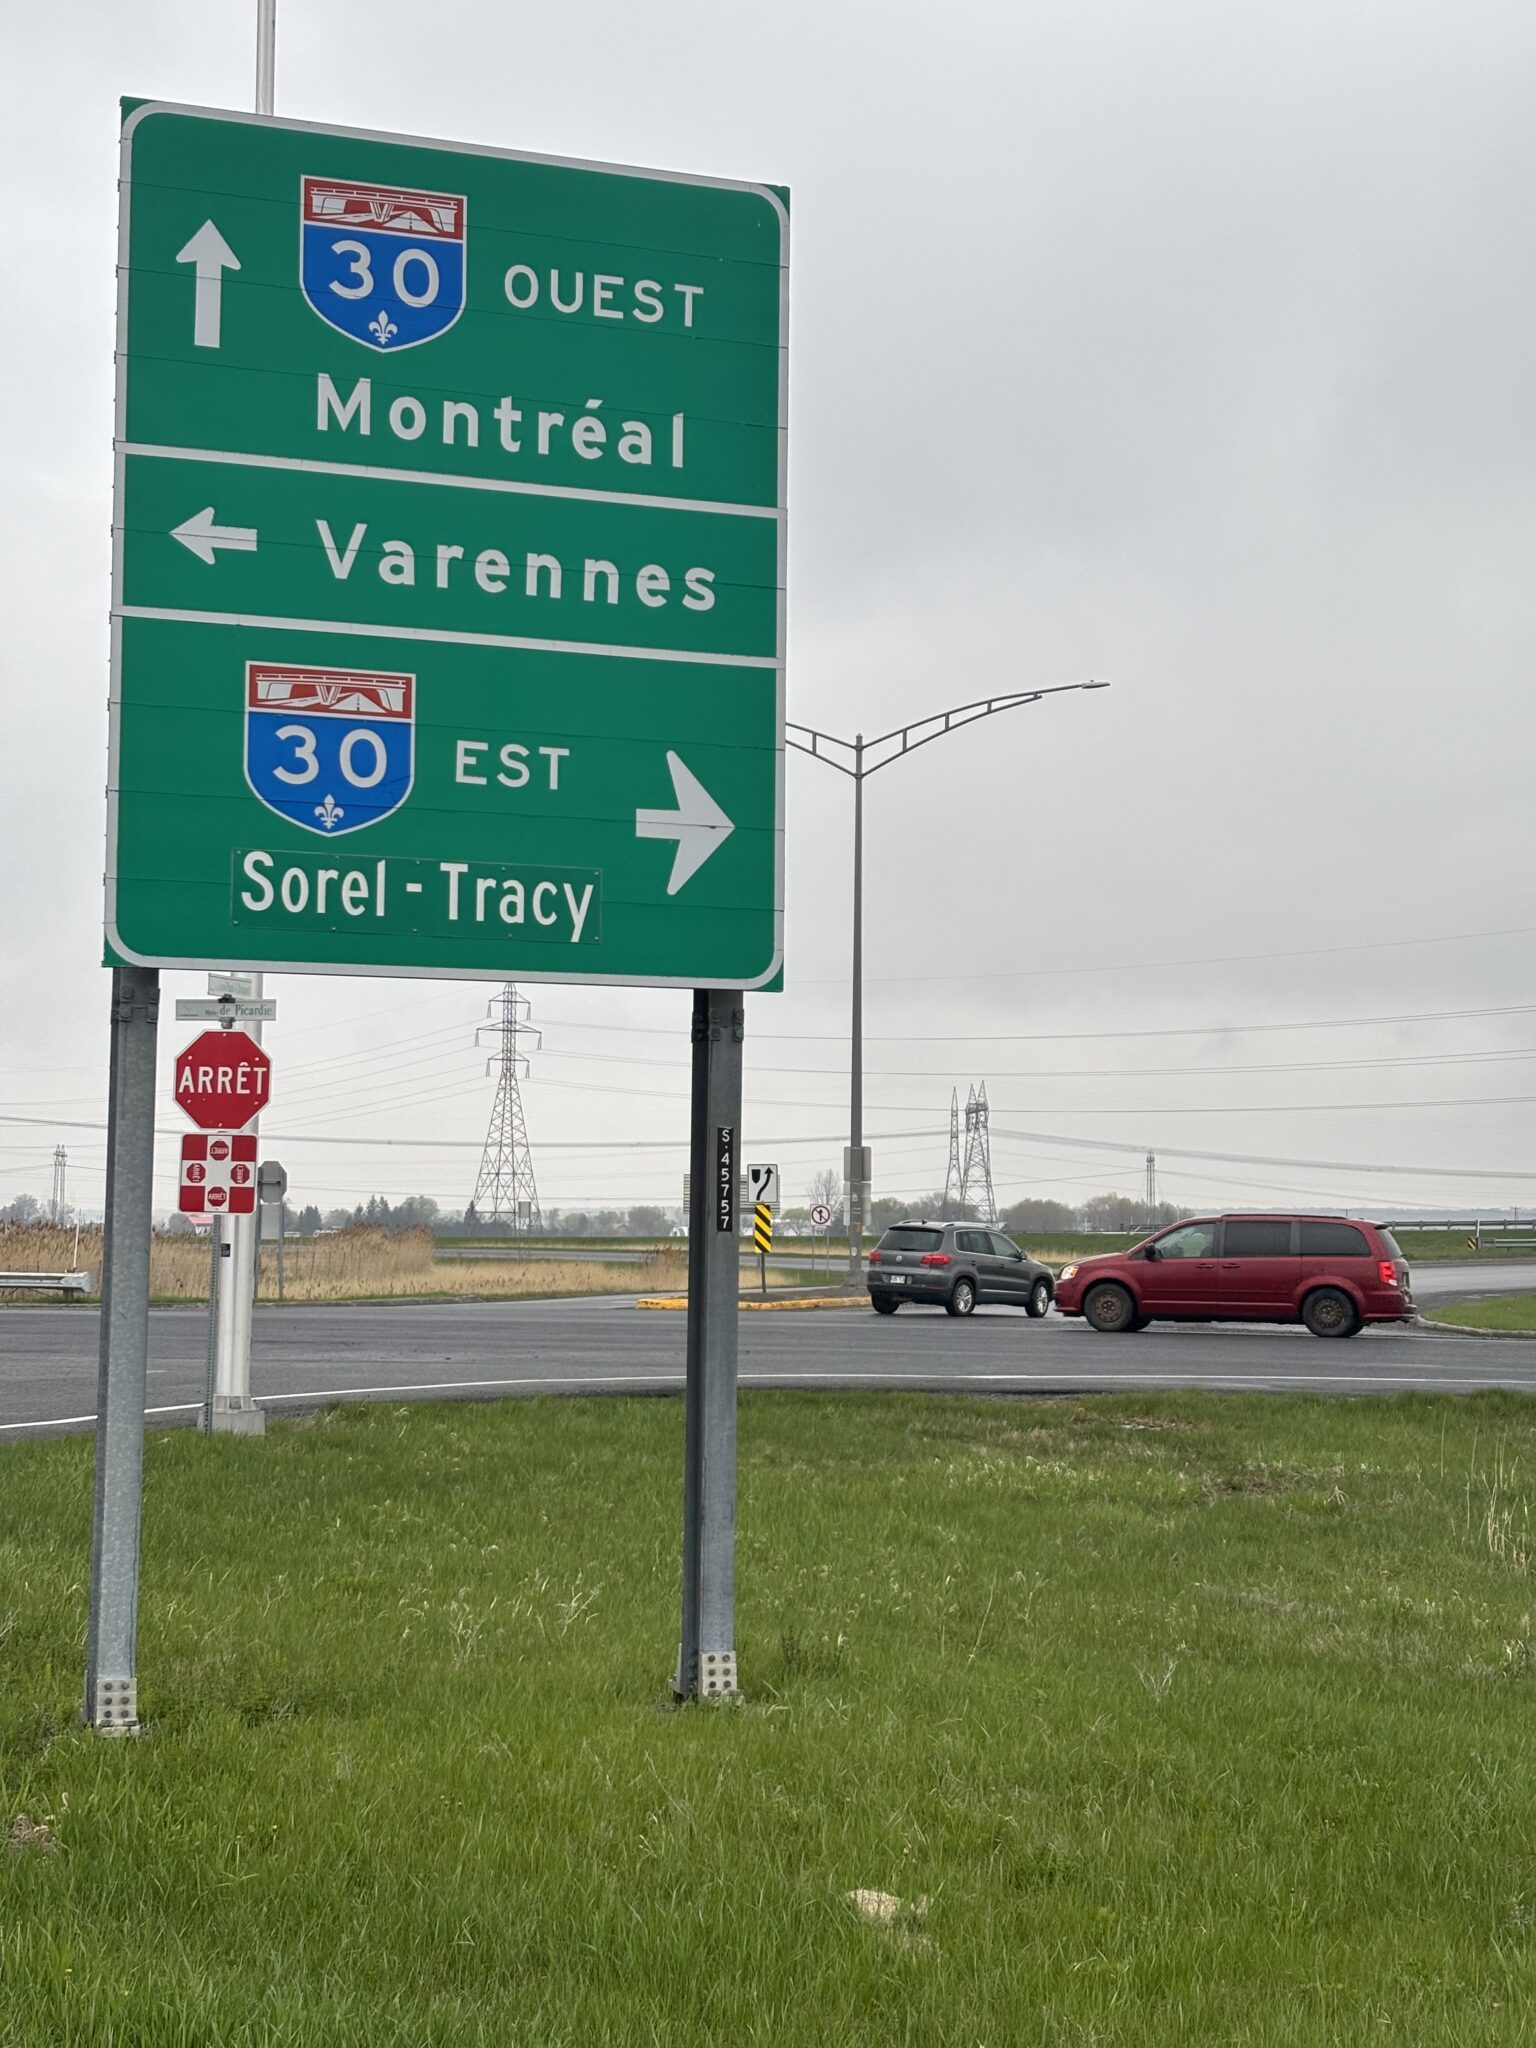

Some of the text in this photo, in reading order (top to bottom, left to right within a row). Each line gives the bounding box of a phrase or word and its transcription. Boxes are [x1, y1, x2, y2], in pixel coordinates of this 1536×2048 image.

[329, 239, 440, 309] 30
[503, 263, 705, 328] OUEST
[316, 373, 685, 468] Montréal
[316, 519, 716, 611] Varennes
[273, 725, 388, 788] 30
[455, 739, 571, 790] EST
[241, 850, 386, 917] Sorel
[439, 861, 595, 943] Tracy
[219, 1004, 231, 1016] de
[235, 1004, 273, 1016] Picardie
[178, 1062, 268, 1094] ARRÊT
